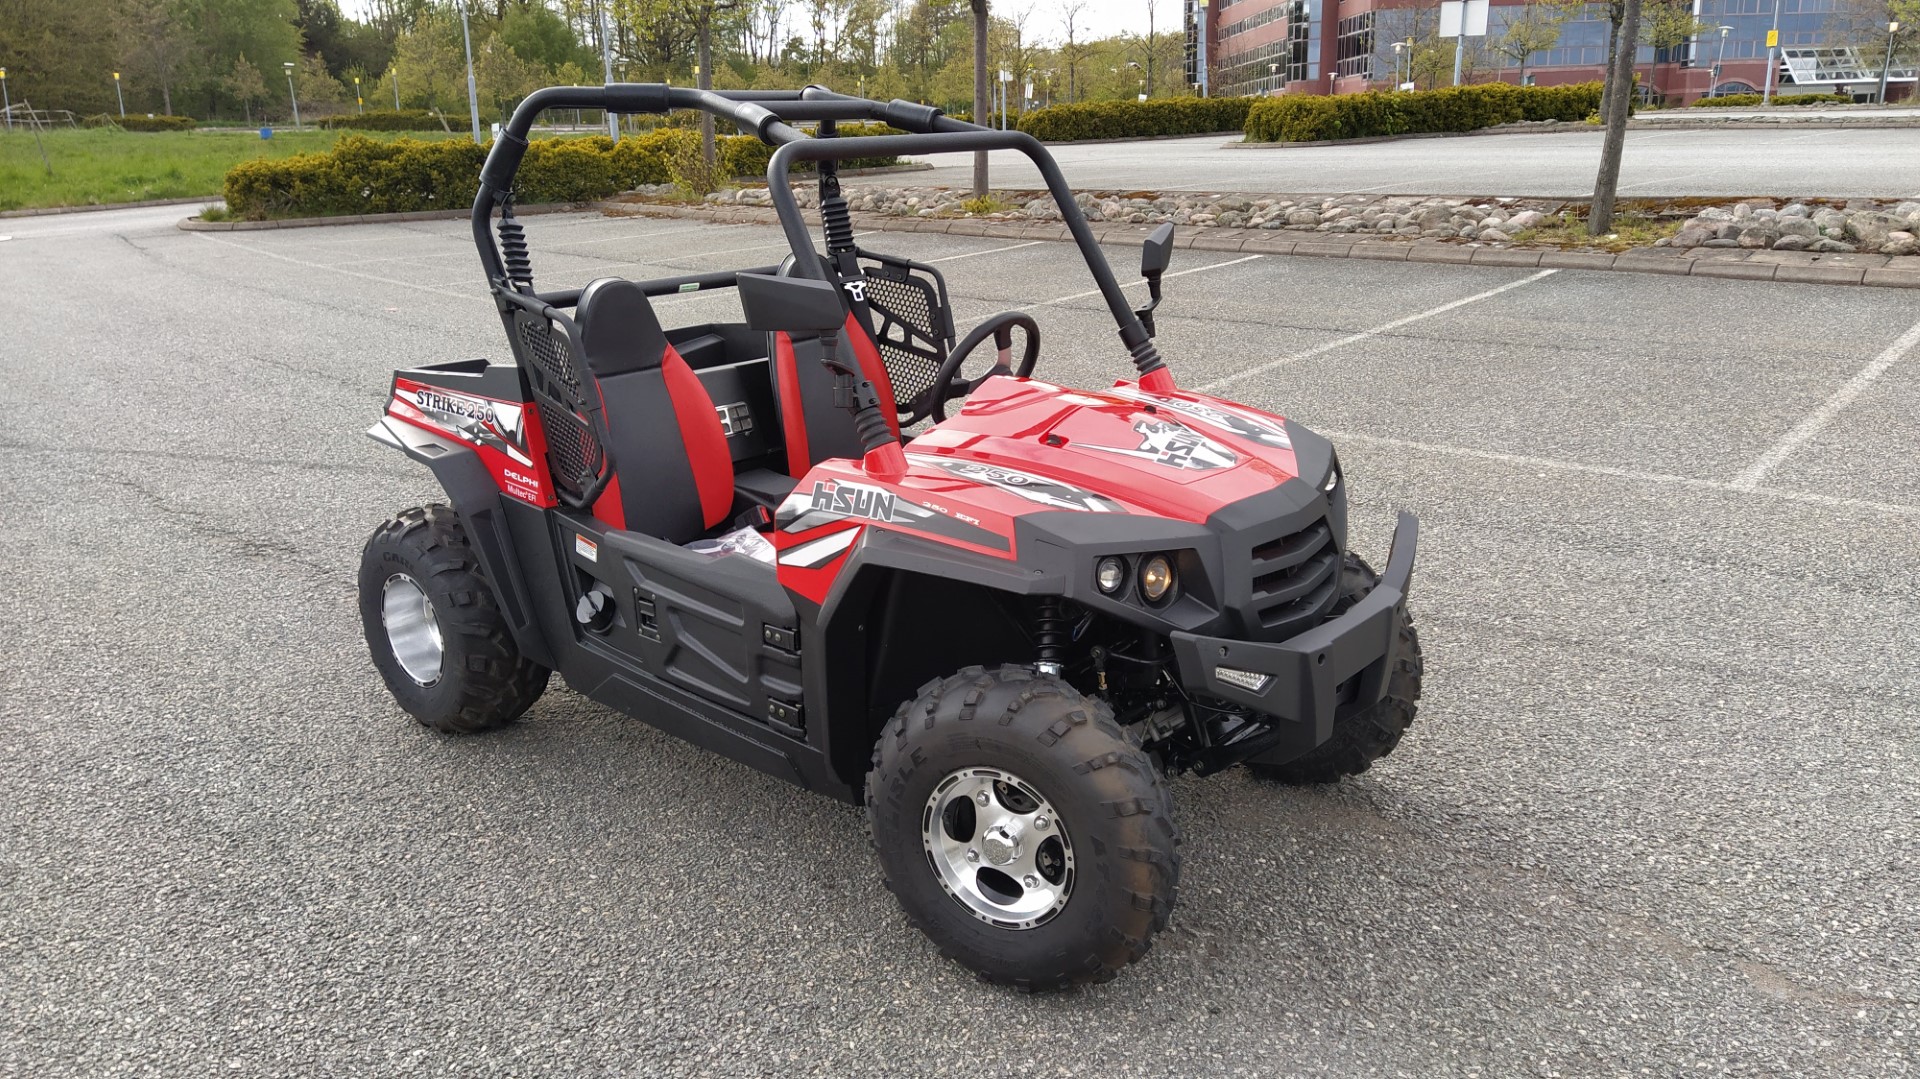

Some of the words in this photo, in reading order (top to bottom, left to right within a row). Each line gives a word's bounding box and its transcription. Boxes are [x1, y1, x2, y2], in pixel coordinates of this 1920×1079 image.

[416, 390, 466, 416] STRIKE
[466, 402, 495, 424] 250
[504, 468, 538, 488] DELPHI
[959, 464, 1030, 485] 250
[811, 480, 897, 522] HSUN
[921, 501, 948, 514] 250
